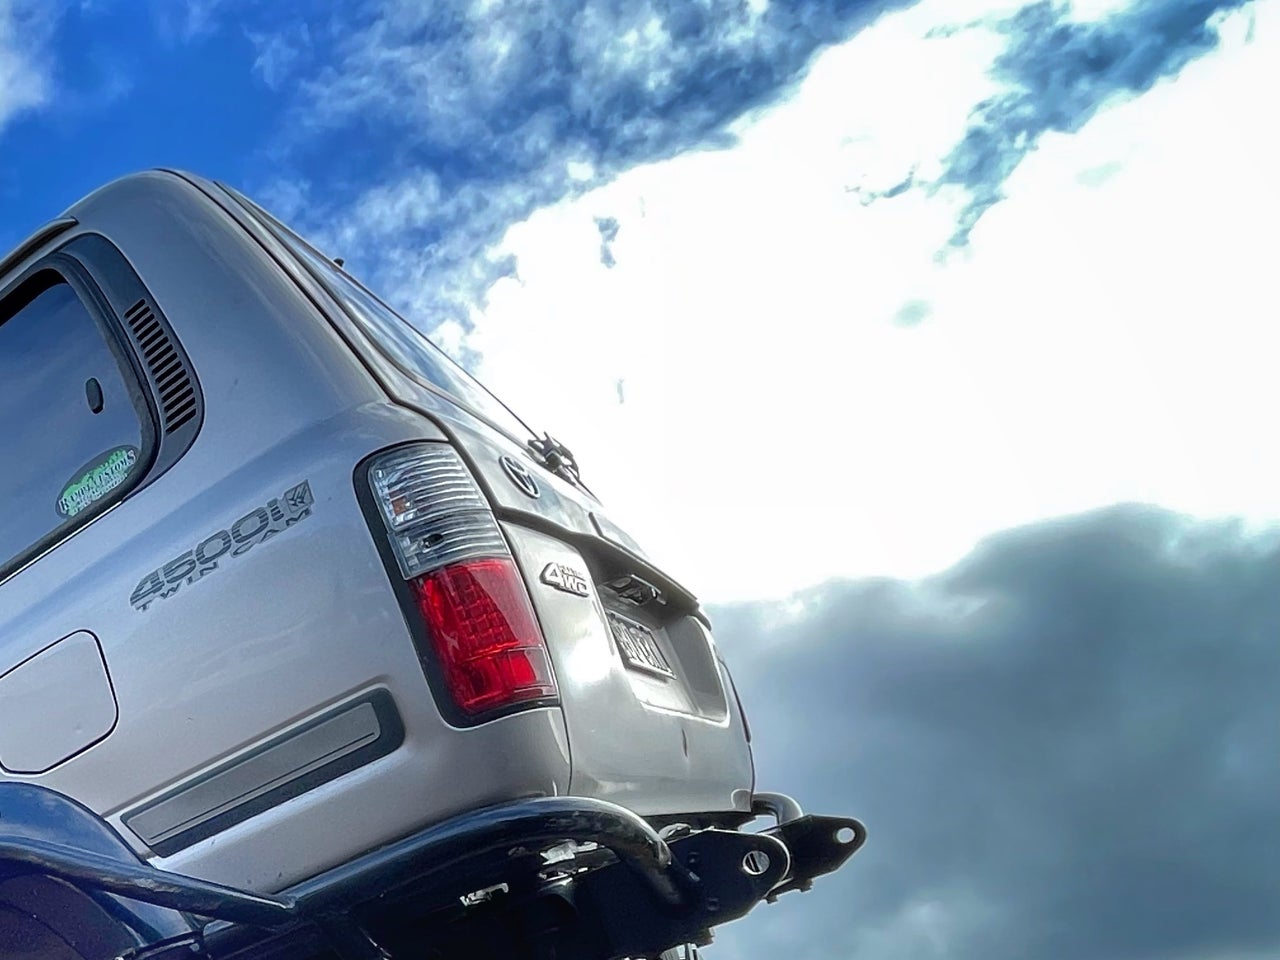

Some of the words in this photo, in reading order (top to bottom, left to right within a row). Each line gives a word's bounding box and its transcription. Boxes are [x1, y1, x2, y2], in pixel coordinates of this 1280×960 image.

[135, 561, 219, 611] TWIN
[232, 508, 312, 556] CAM
[541, 561, 589, 597] 4WD
